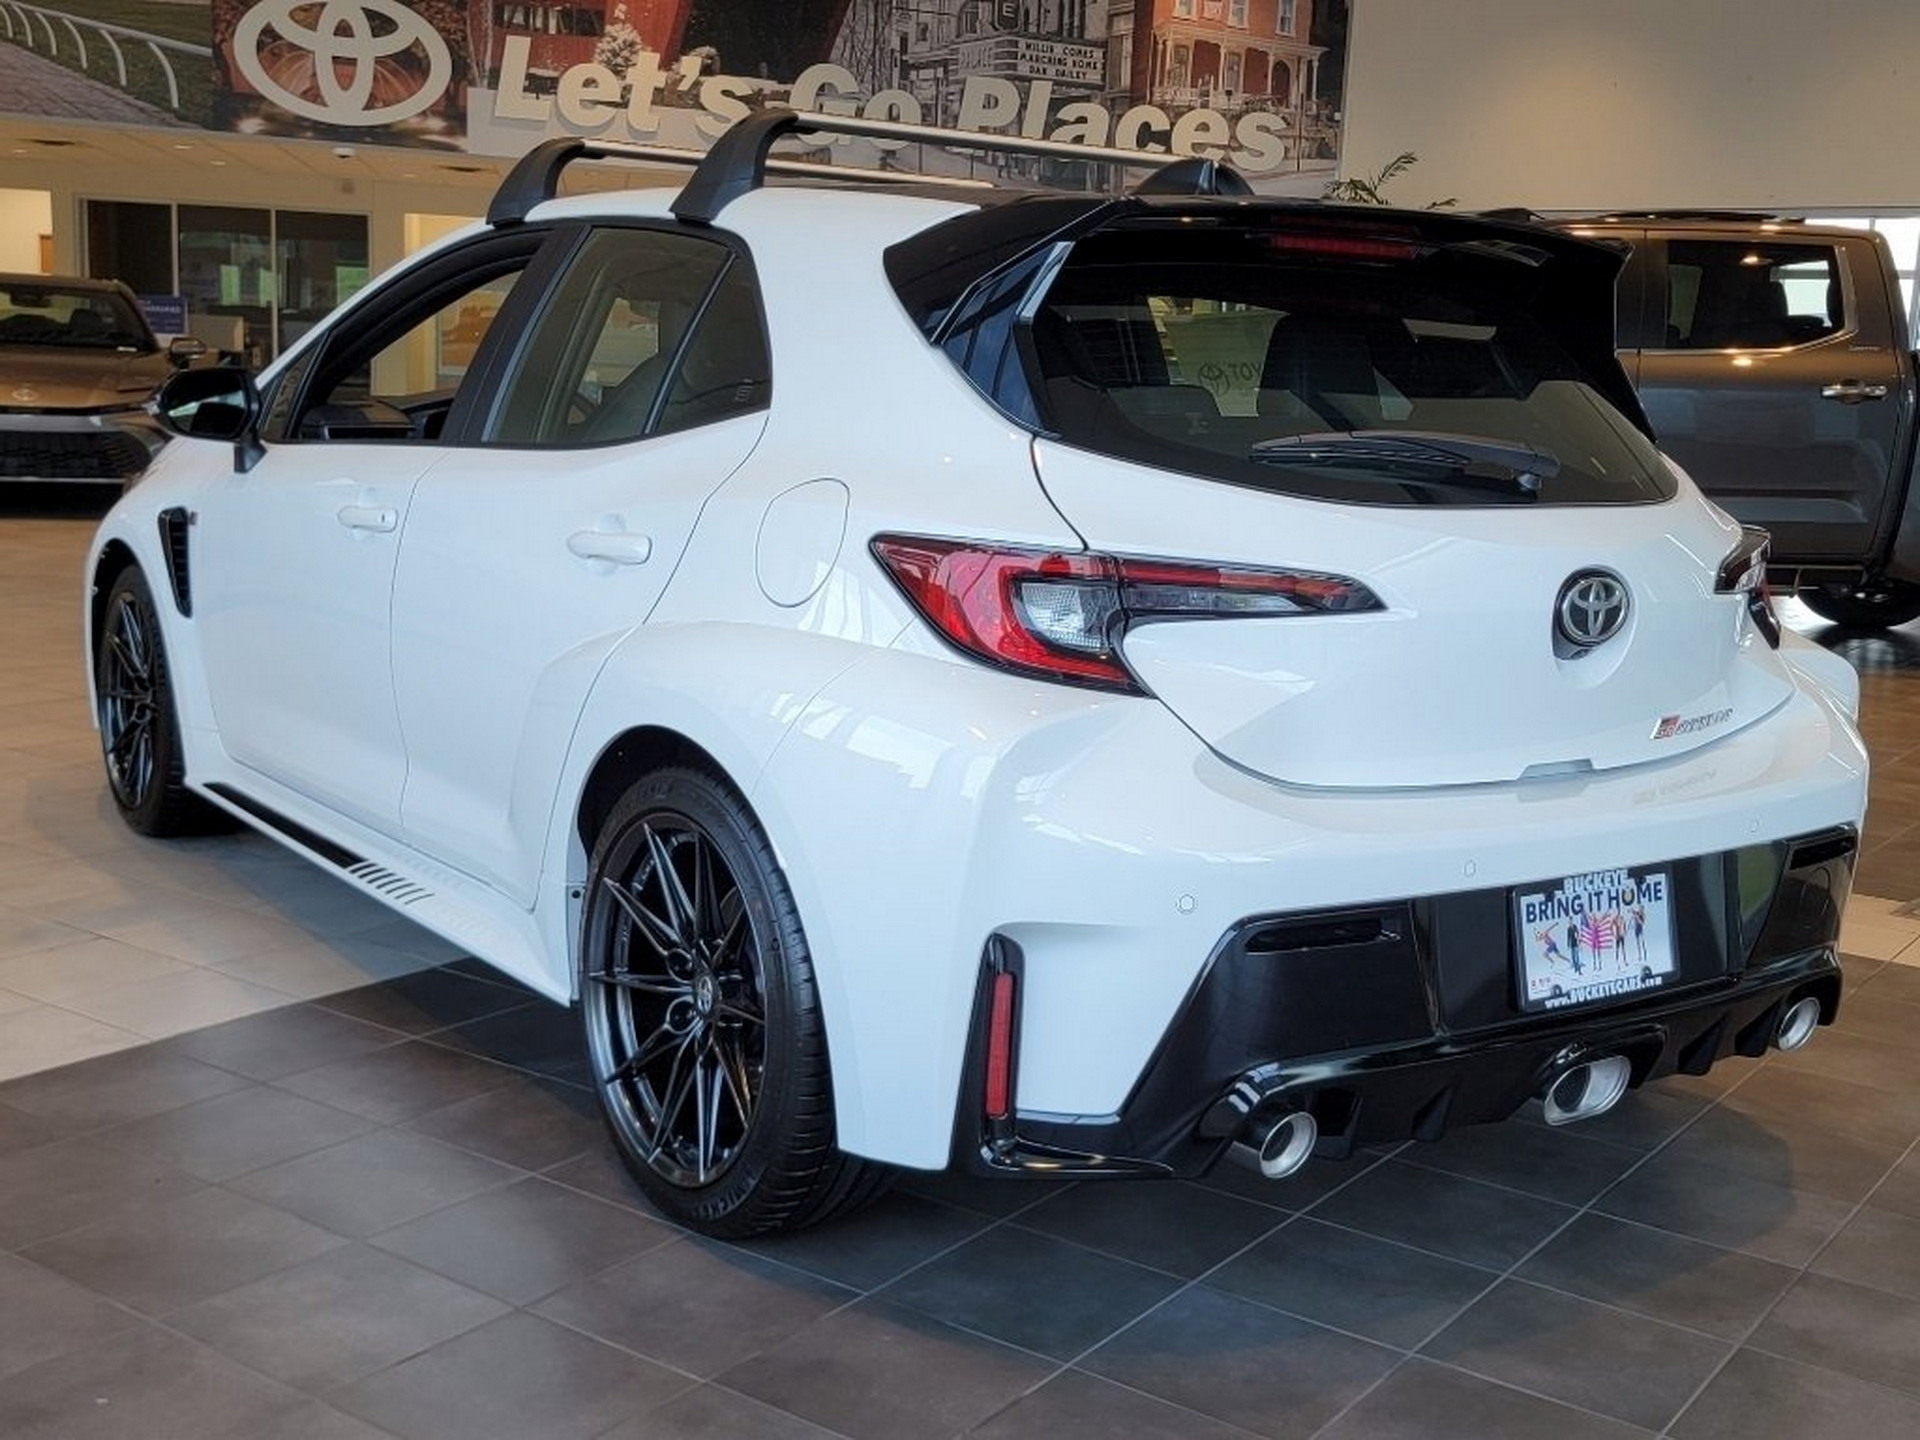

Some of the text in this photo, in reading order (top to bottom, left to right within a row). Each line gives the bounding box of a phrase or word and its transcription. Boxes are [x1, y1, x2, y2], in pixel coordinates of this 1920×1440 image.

[495, 34, 1290, 172] Let's Go Places
[1525, 893, 1584, 923] BRING
[1588, 890, 1604, 913] IT
